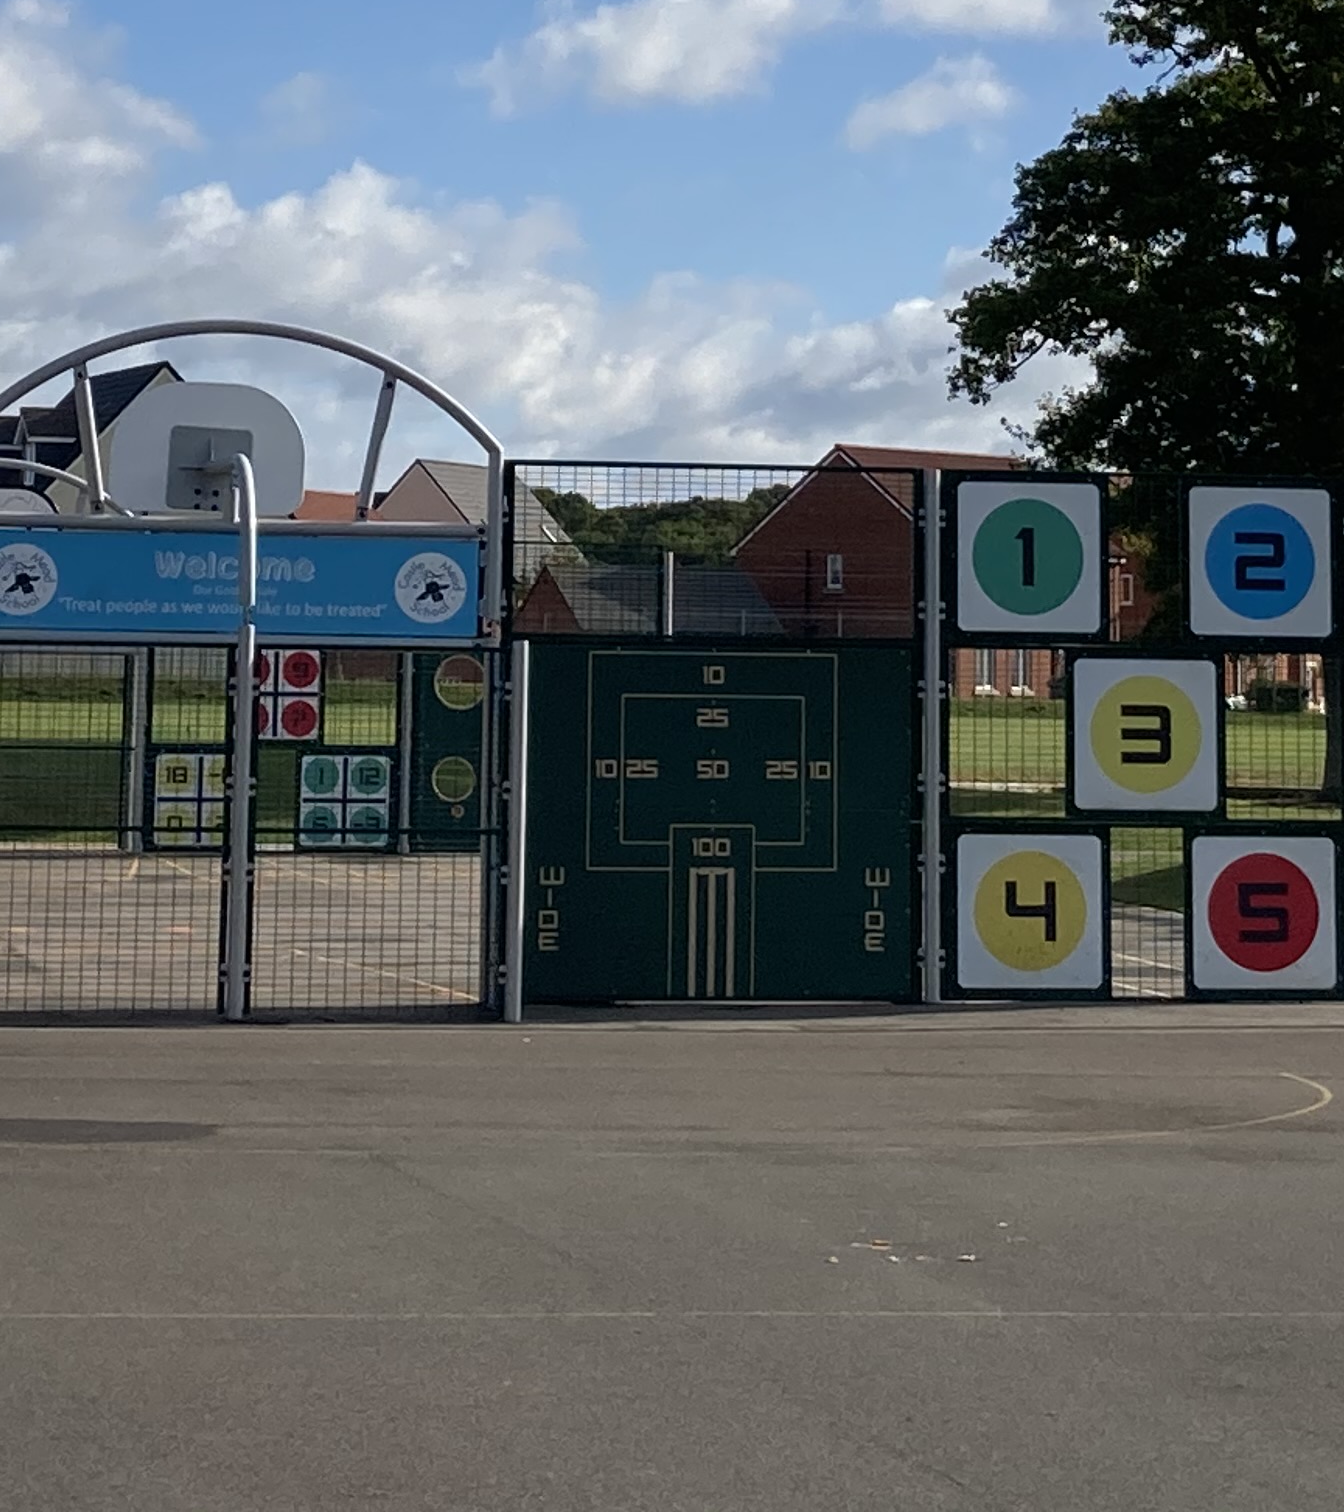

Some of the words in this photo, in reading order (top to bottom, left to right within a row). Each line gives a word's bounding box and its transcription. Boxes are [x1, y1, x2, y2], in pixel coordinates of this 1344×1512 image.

[155, 550, 317, 583] Welcme
[1013, 526, 1036, 588] 1
[1234, 530, 1286, 593] 2
[105, 599, 157, 616] people
[161, 602, 177, 614] as
[180, 603, 203, 614] we
[702, 665, 726, 685] 10
[696, 708, 729, 728] 25
[1119, 704, 1172, 765] 3
[359, 766, 381, 786] 12
[595, 759, 618, 779] 10
[625, 759, 658, 779] 25
[696, 760, 730, 780] 50
[765, 760, 799, 780] 25
[809, 760, 831, 780] 10
[691, 837, 731, 857] 100
[1004, 880, 1057, 942] 4
[1237, 882, 1289, 943] 5
